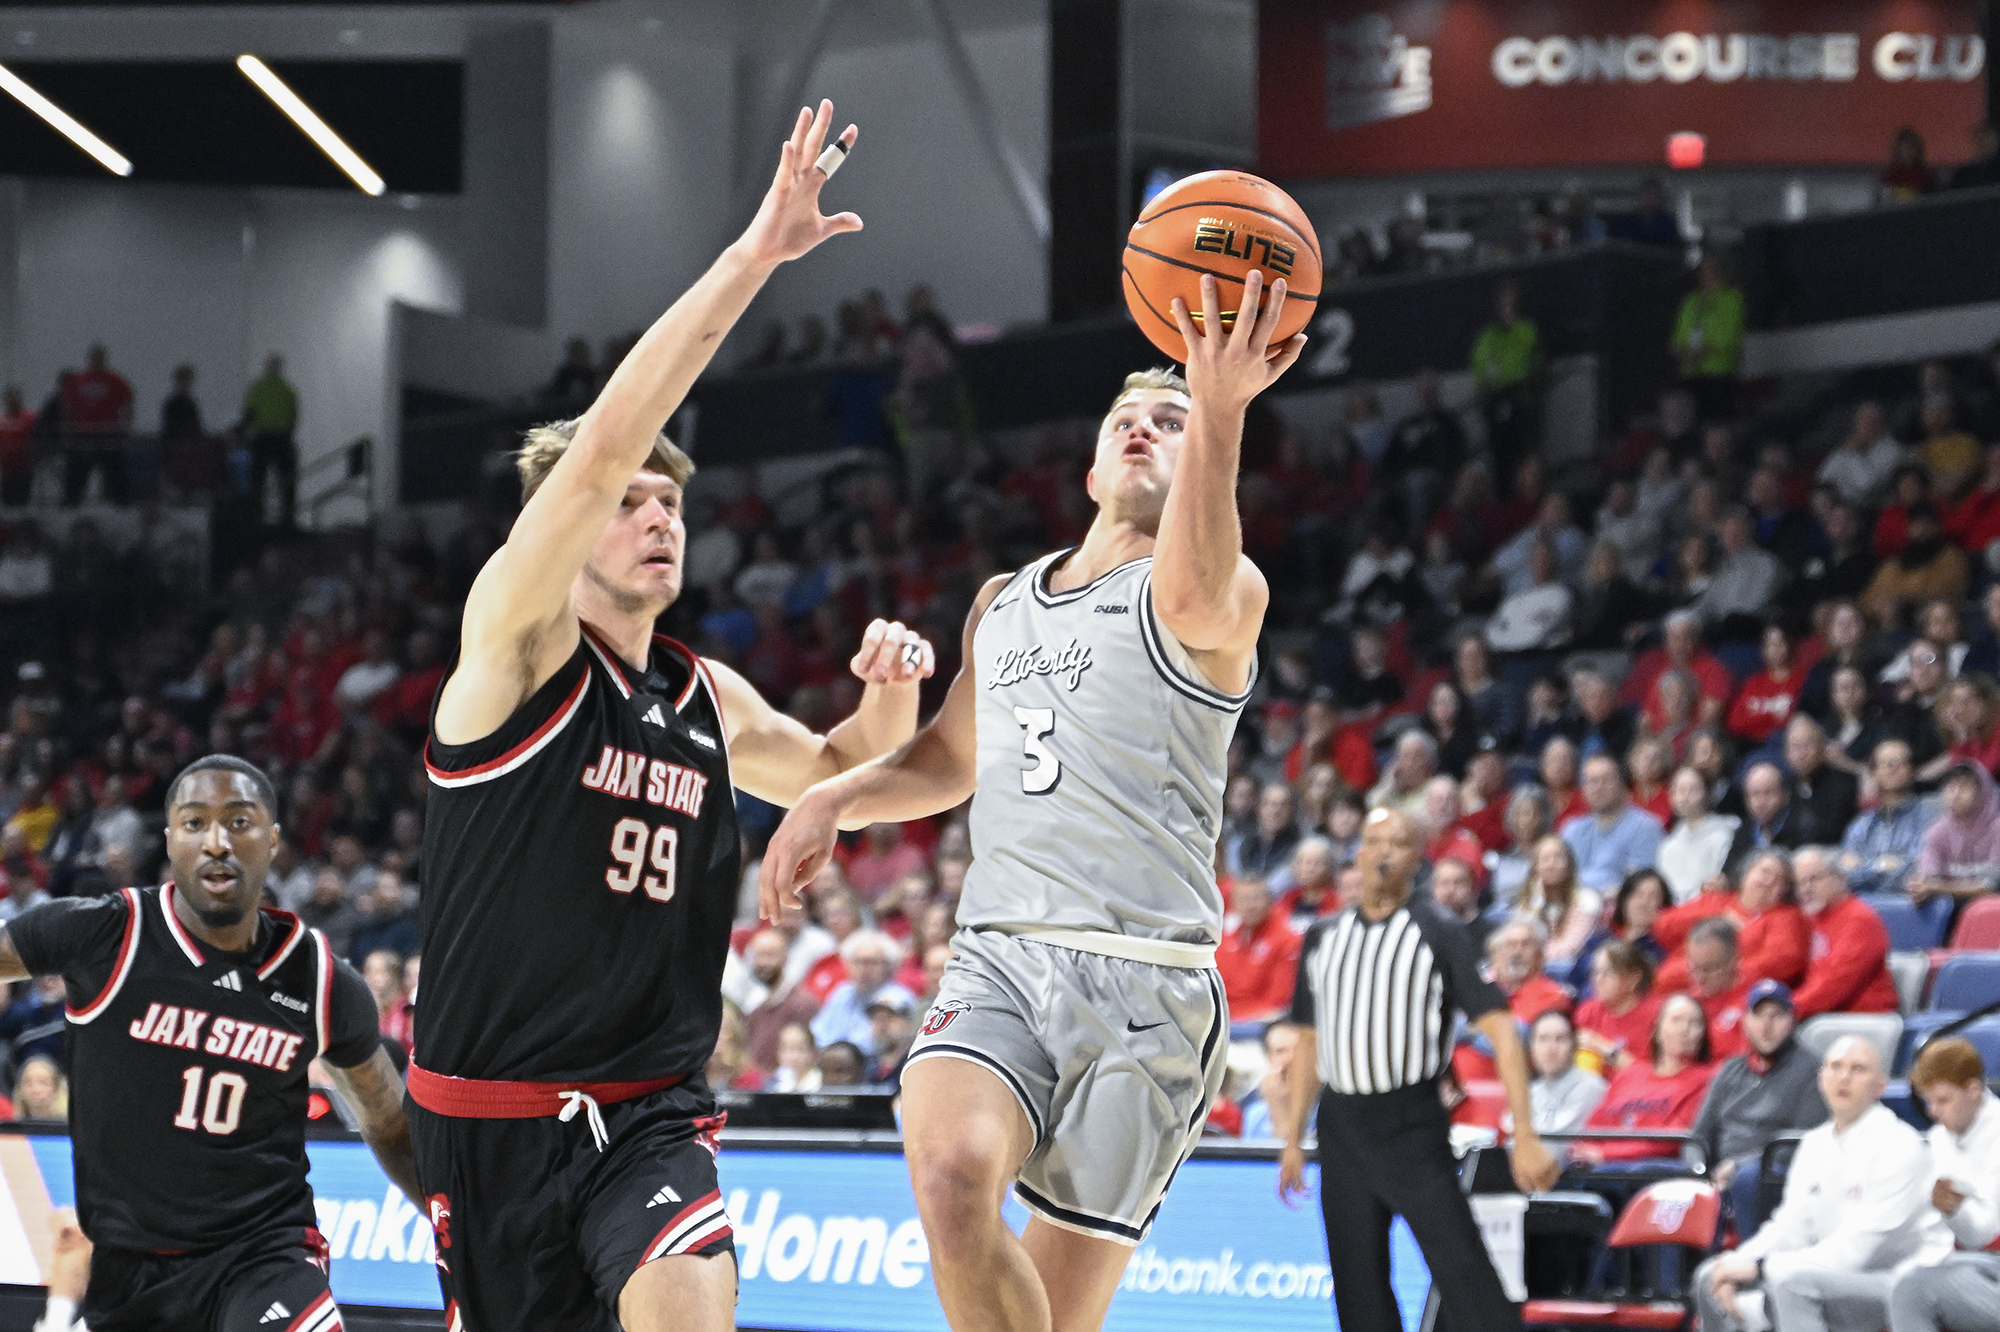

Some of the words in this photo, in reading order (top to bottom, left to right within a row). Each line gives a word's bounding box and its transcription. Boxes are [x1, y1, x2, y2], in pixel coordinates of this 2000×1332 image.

[1492, 32, 1859, 87] CONCOURSE
[1194, 224, 1295, 277] ELITE
[987, 637, 1093, 692] Liberty
[581, 744, 647, 801] JAX
[646, 758, 709, 819] STATE
[1013, 705, 1062, 795] 3
[605, 816, 678, 903] 99
[129, 1001, 210, 1050] JAX
[204, 1015, 305, 1073] STATE
[173, 1065, 248, 1136] 10
[728, 1188, 931, 1288] Home
